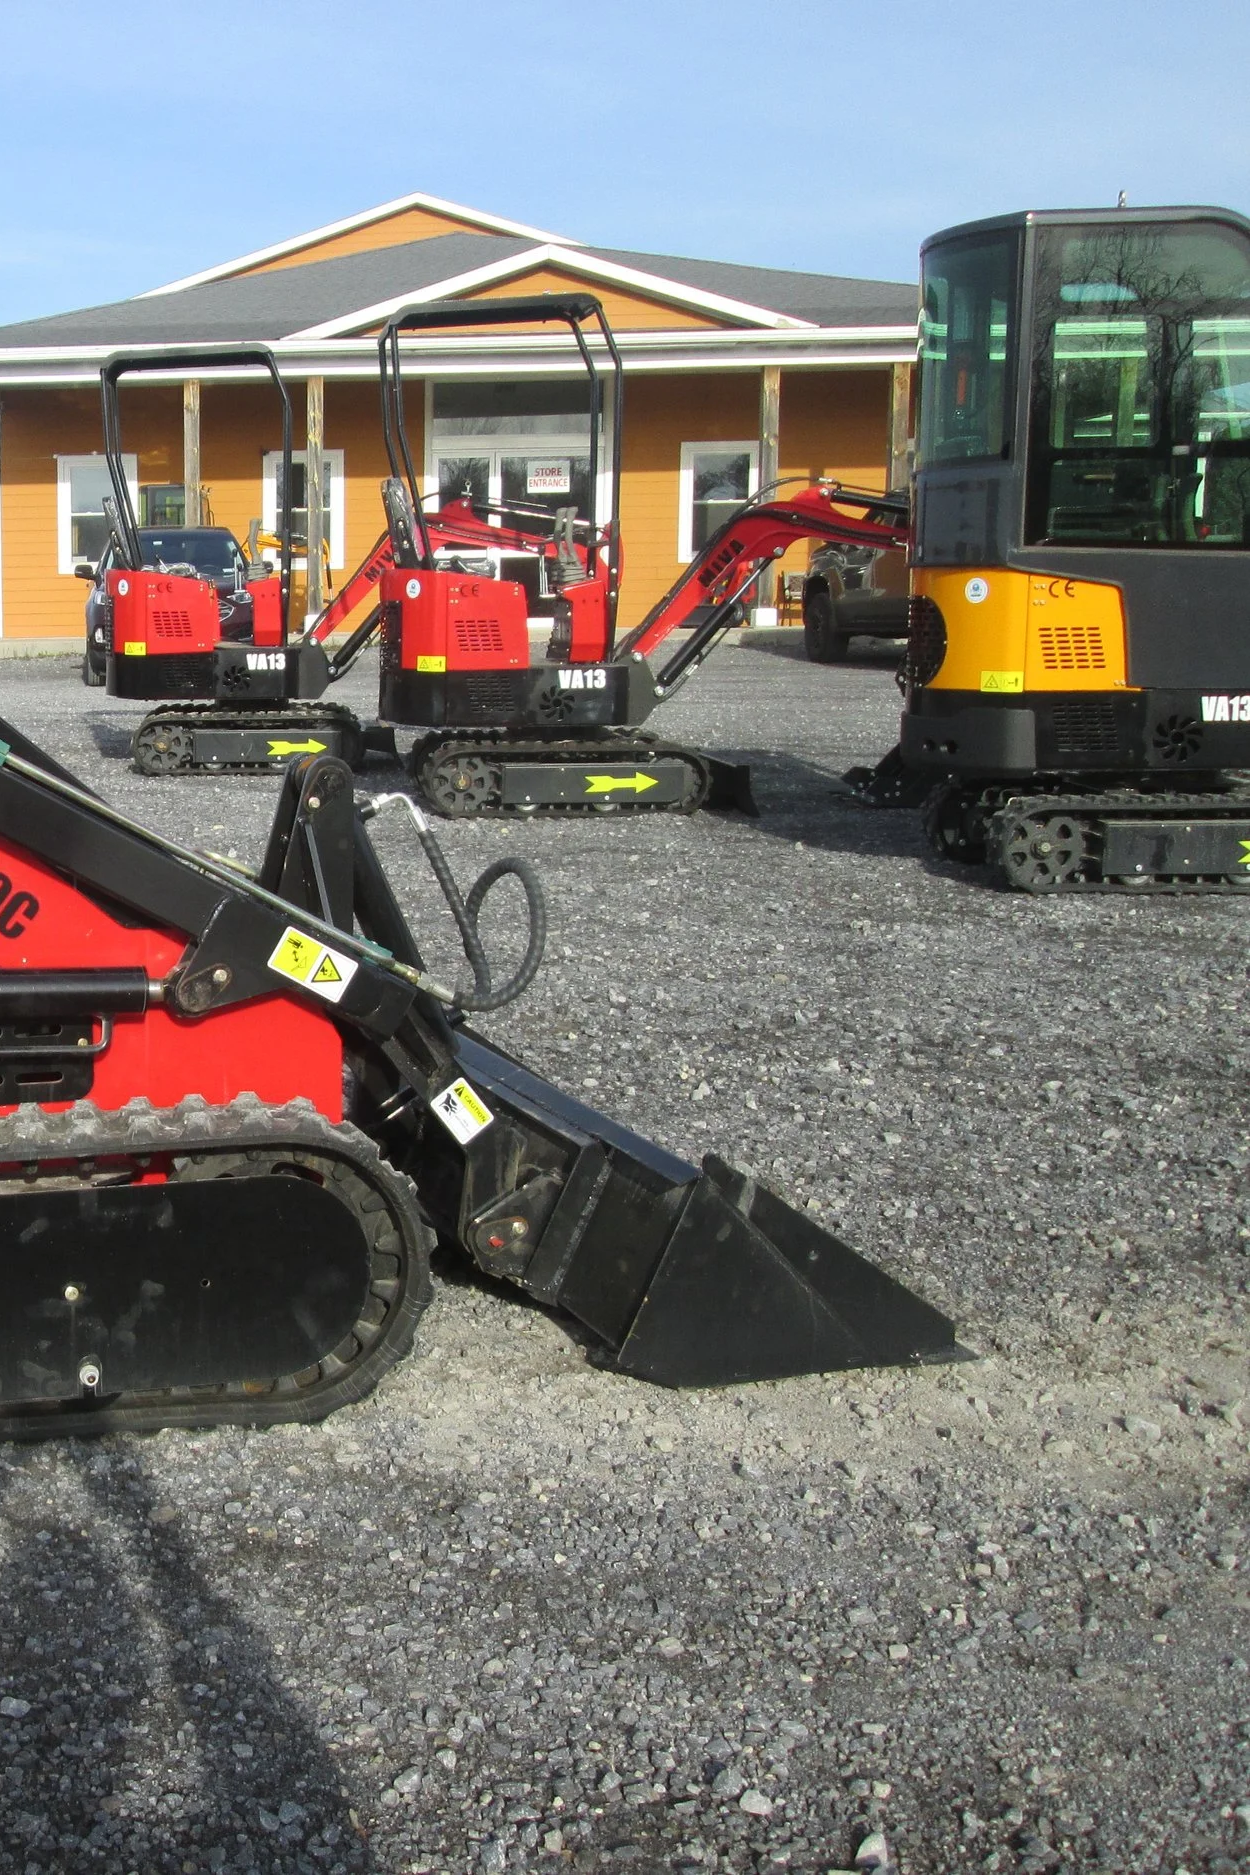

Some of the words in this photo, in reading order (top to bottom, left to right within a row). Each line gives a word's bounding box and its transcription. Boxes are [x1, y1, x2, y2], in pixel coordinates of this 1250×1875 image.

[534, 467, 562, 477] STORE
[529, 478, 568, 488] ENTRANCE
[246, 653, 286, 670] VA13
[558, 669, 607, 689] VA13
[464, 1095, 486, 1122] CAUTION
